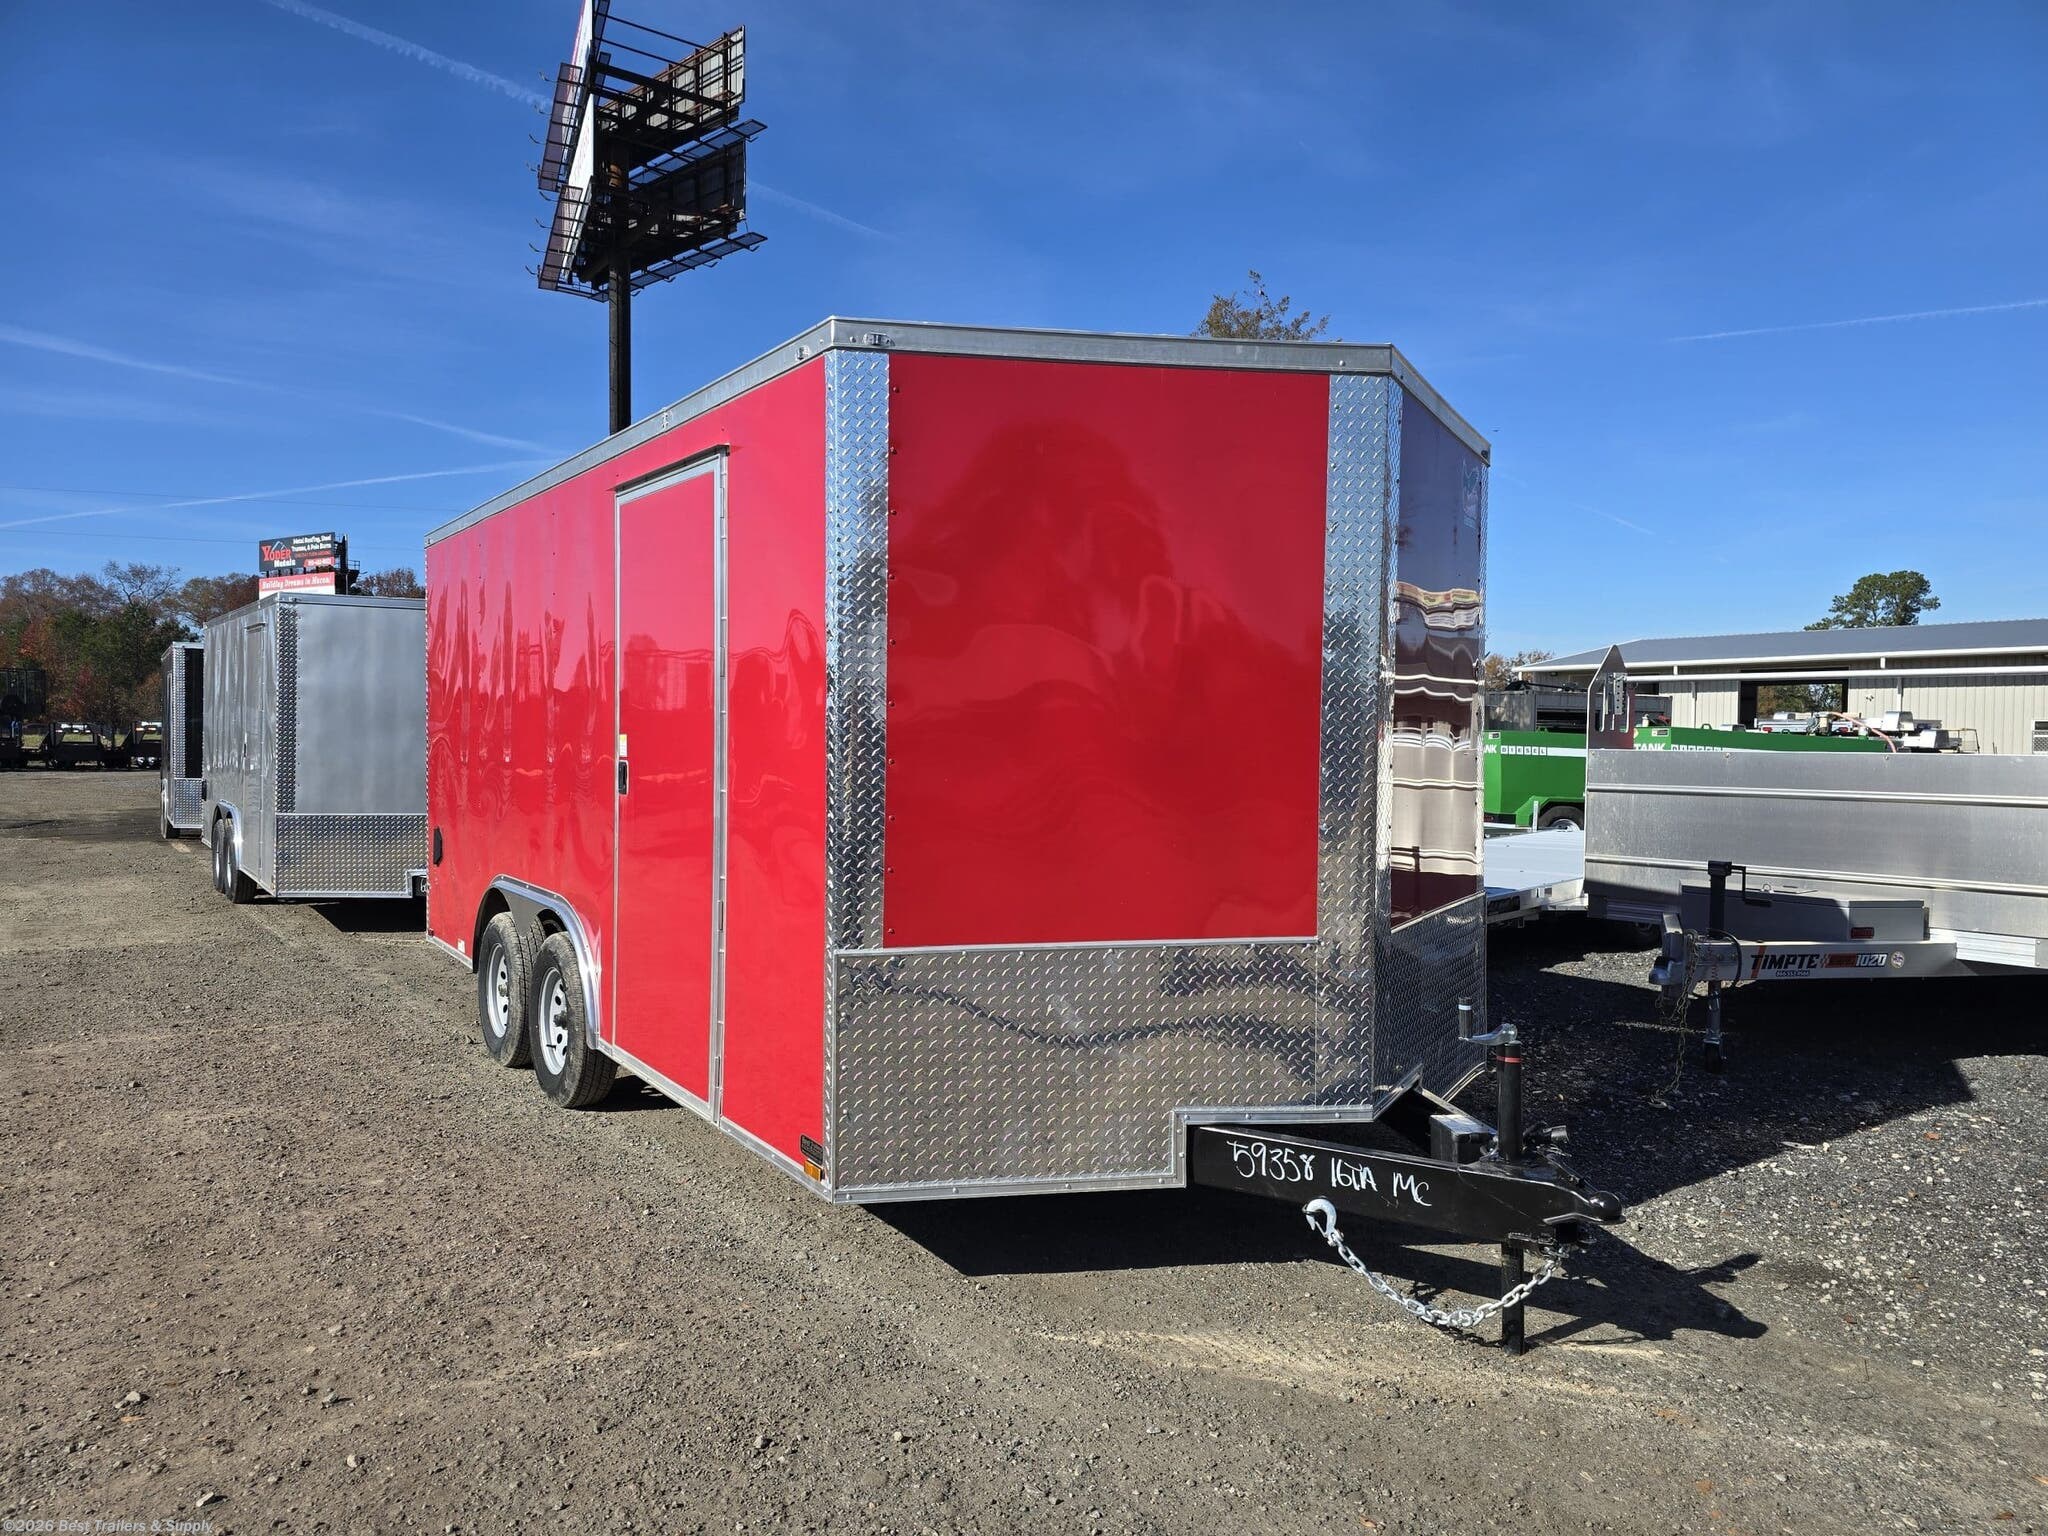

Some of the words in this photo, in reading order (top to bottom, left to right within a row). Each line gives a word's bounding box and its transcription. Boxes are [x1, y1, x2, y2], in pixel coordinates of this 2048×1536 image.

[274, 559, 296, 568] Metals
[1750, 953, 1820, 970] TIMPTE
[1855, 954, 1888, 967] 1020
[1226, 1140, 1315, 1182] 59358
